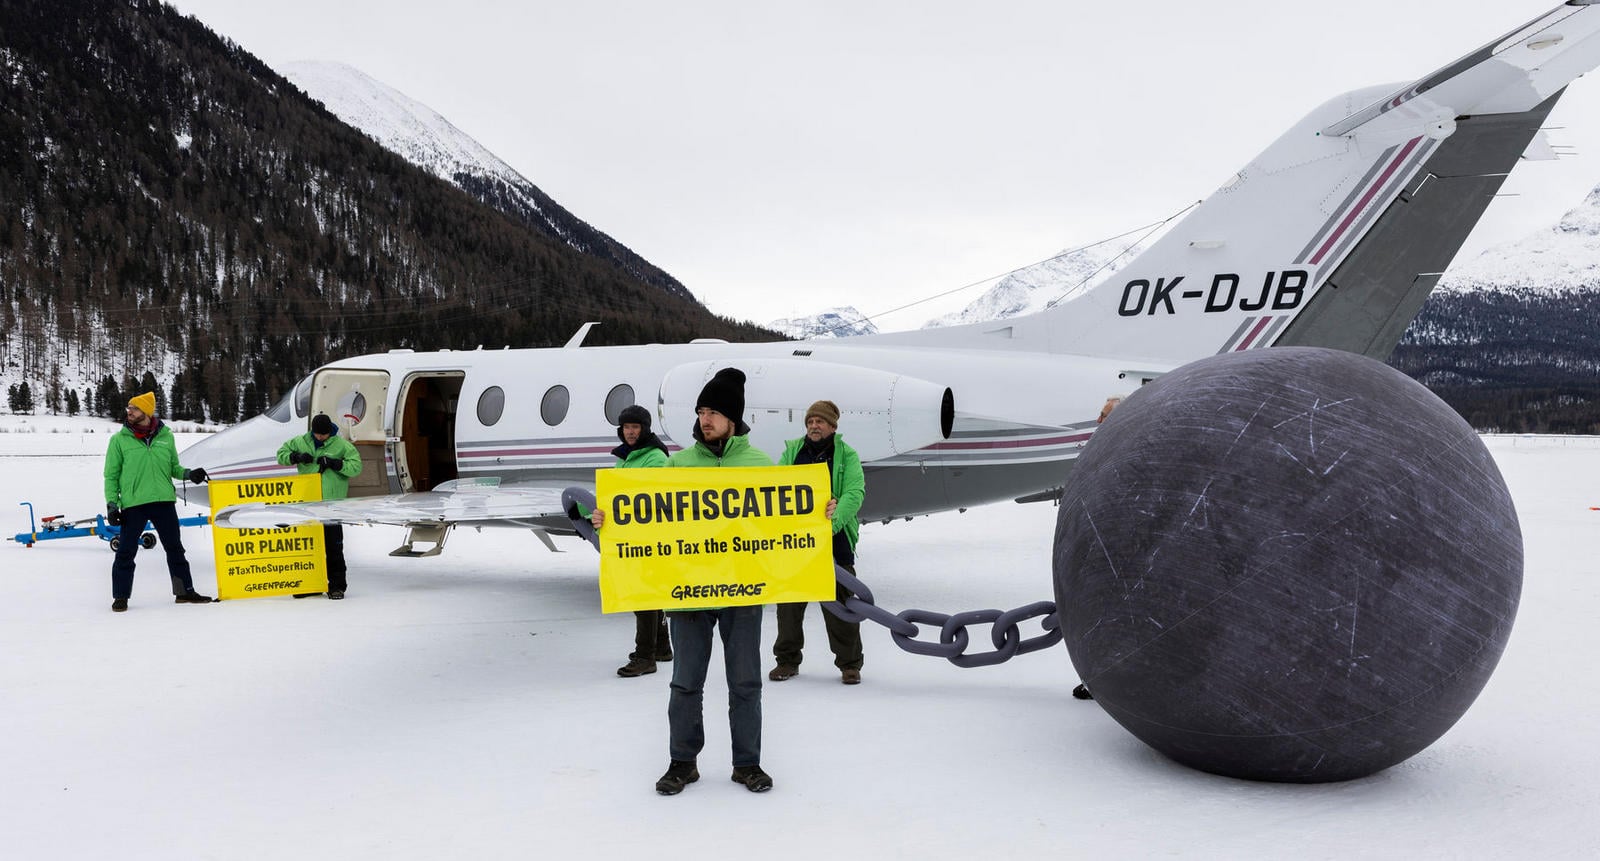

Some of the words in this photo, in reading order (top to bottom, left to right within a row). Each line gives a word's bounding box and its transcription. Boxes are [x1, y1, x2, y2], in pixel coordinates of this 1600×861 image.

[1118, 270, 1309, 317] OK-DJB
[238, 482, 293, 498] LUXURY
[612, 485, 814, 525] CONFISCATED
[225, 541, 254, 556] OUR
[259, 537, 314, 554] PLANET!
[616, 541, 653, 559] Time
[657, 541, 672, 557] to
[676, 539, 700, 556] Tax
[704, 538, 728, 554] the
[732, 533, 816, 554] Super-Rich
[228, 562, 314, 576] #TaxTheSuperRich
[245, 580, 302, 592] GREENPEACE
[671, 582, 766, 601] GREENPEACE
